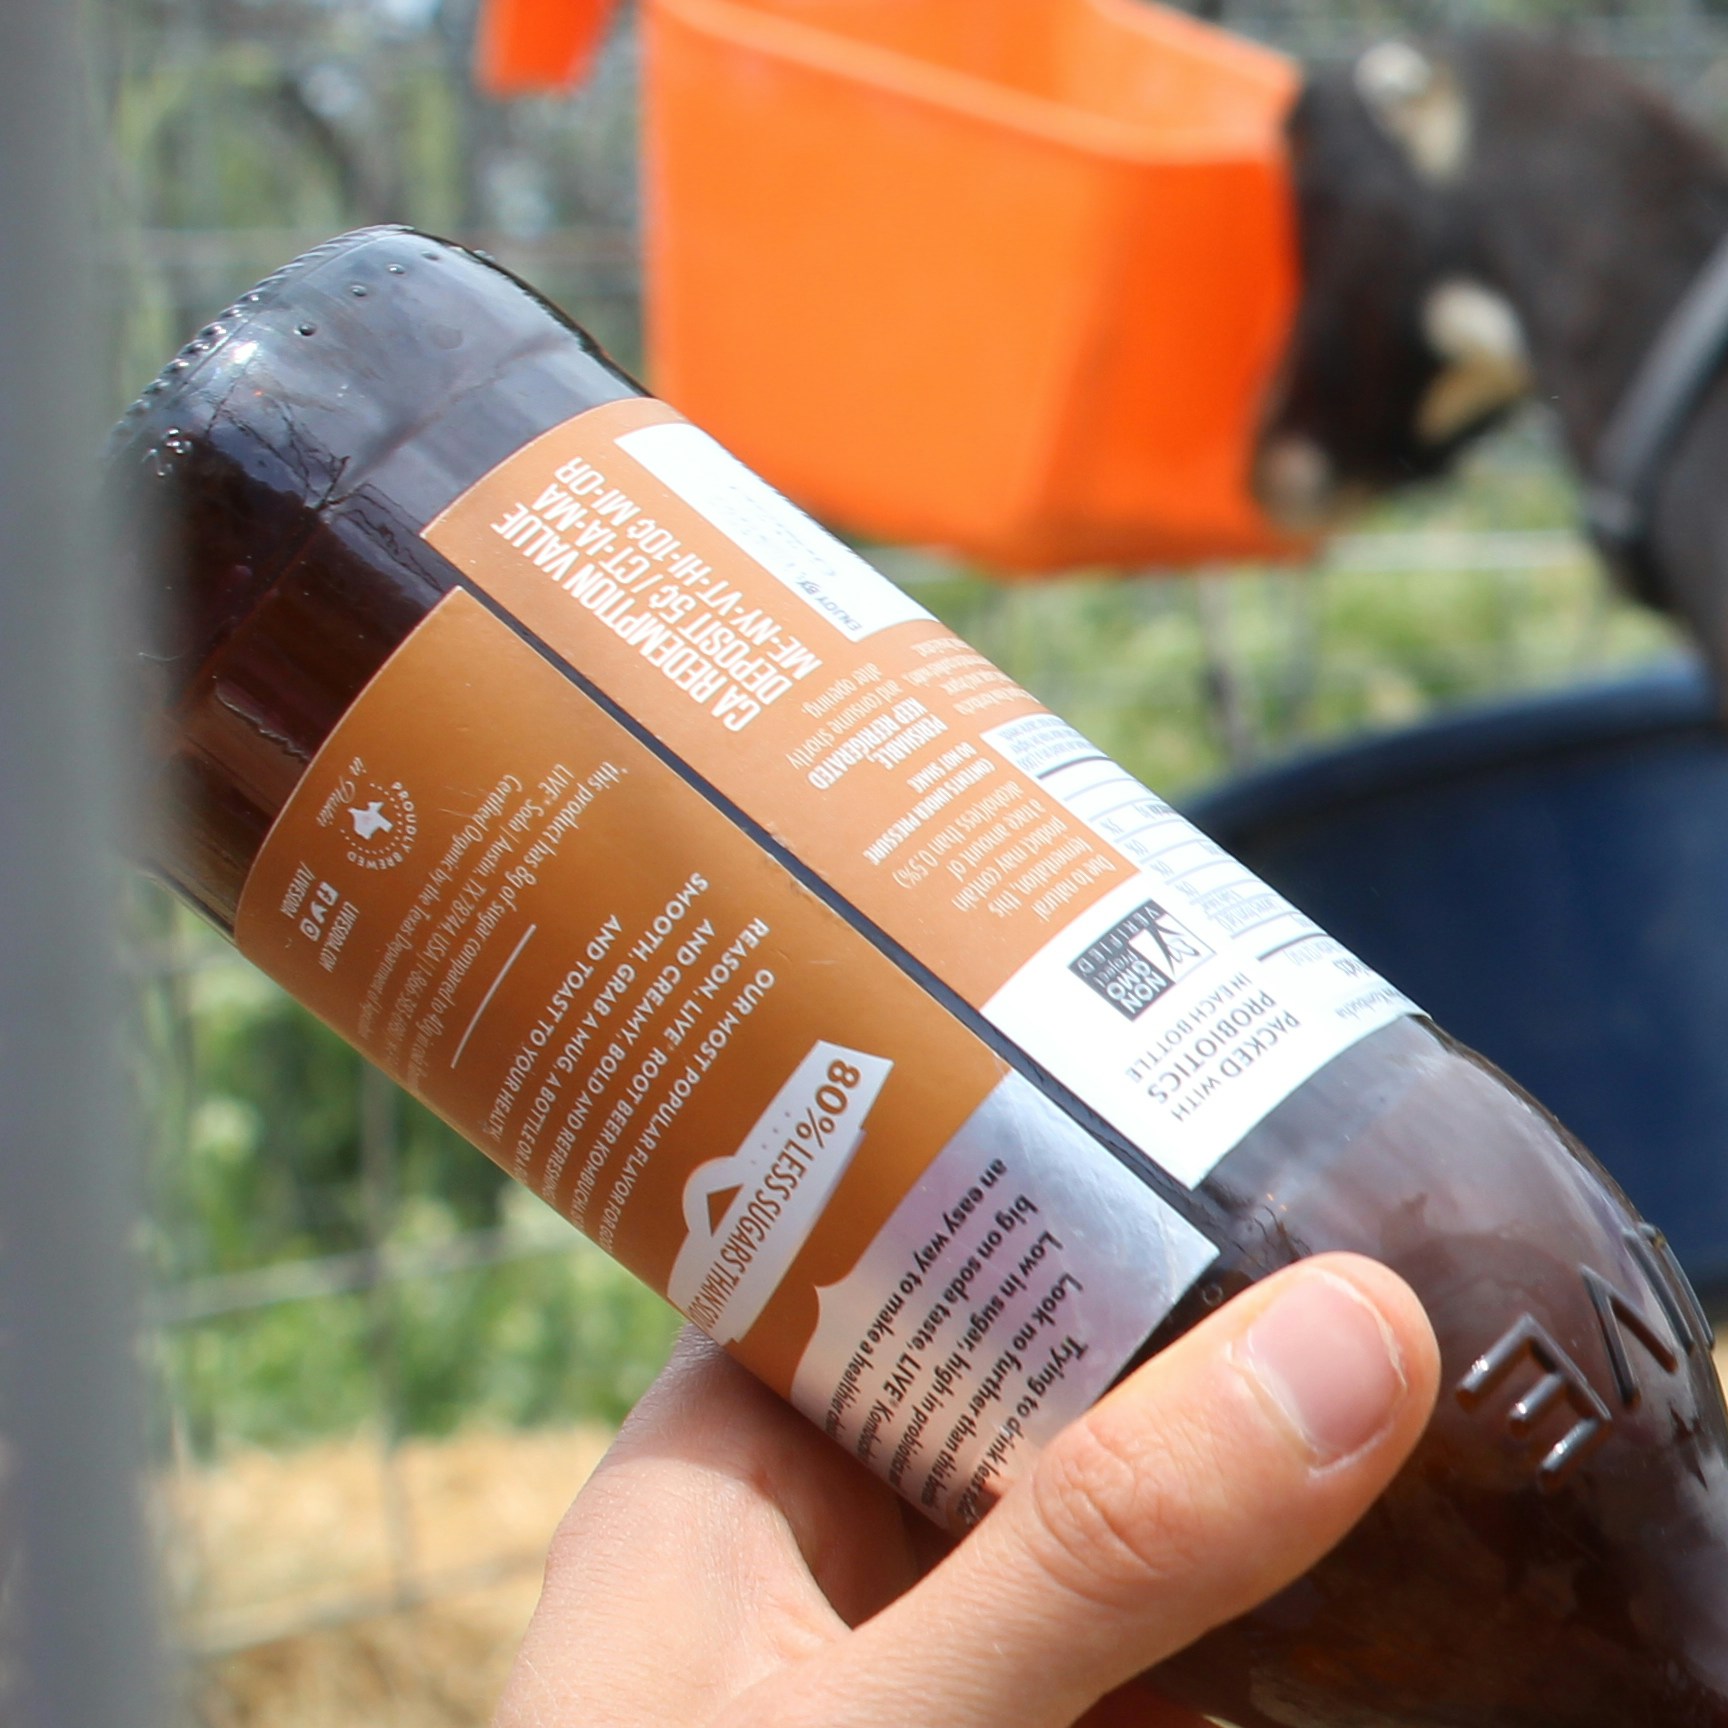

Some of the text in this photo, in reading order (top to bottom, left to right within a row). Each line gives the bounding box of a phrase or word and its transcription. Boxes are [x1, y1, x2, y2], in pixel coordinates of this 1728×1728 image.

[551, 455, 641, 527] MI-OR
[529, 480, 654, 586] CT-IA-MA
[488, 501, 762, 734] CA REDEMPTION VALUE
[643, 579, 698, 627] 5¢
[812, 593, 863, 633] ENJOY
[674, 613, 793, 706] DEPOSIT
[848, 660, 883, 685] after
[798, 676, 856, 721] opening.
[825, 691, 883, 736] consume
[873, 677, 903, 705] and
[887, 695, 928, 725] KEEP
[784, 727, 835, 771] shortly
[804, 711, 902, 792] REFRIGERATED
[864, 712, 949, 773] PERISHABLE,
[936, 748, 965, 772] NOT
[952, 739, 977, 759] DO
[313, 755, 369, 829] in Austin
[471, 770, 524, 832] Certified
[904, 761, 947, 794] SHAKE
[343, 780, 419, 872] PROUDLY BREWED
[506, 798, 543, 836] Soda
[541, 781, 595, 845] product
[860, 755, 996, 867] CONTENTS UNDER PRESSURE
[890, 778, 1025, 891] alcohol(less than 0.5%)
[439, 822, 484, 874] Organic
[471, 833, 514, 880] Austin,
[522, 838, 556, 870] has
[943, 797, 1047, 884] a trace amount of
[950, 814, 1068, 916] product may contain
[277, 859, 316, 920] /LIVESODA
[416, 882, 442, 909] the
[426, 866, 454, 888] by
[462, 876, 487, 900] TX
[496, 883, 520, 911] of
[504, 864, 537, 892] 8g
[985, 835, 1094, 919] fermentation, this
[1029, 853, 1118, 923] Due to natural
[314, 900, 360, 974] LIVESODA.COM
[398, 902, 431, 938] Texas
[437, 892, 474, 938] 78744,
[471, 900, 504, 940] sugar
[583, 913, 622, 963] AND
[367, 929, 410, 999] Department
[421, 930, 452, 963] USA
[672, 918, 715, 971] AND
[693, 915, 770, 1003] REASON,
[1072, 904, 1161, 981] VERIFIED
[437, 936, 481, 1006] compared
[543, 957, 593, 1022] TOAST
[591, 961, 636, 1017] GRAB
[730, 965, 776, 1018] OUR
[1090, 948, 1138, 990] Project
[1103, 957, 1153, 1002] GMO
[1119, 969, 1168, 1016] NON
[364, 989, 386, 1009] of
[428, 995, 449, 1015] to
[580, 1010, 600, 1031] A
[615, 961, 682, 1048] CREAMY,
[414, 1011, 446, 1042] 40g
[525, 1016, 555, 1051] TO
[551, 1026, 590, 1077] MUG,
[689, 1010, 741, 1072] MOST
[1123, 970, 1253, 1085] IN EACH BOTTLE
[1144, 988, 1277, 1106] PROBIOTICS
[501, 1043, 538, 1094] YOUR
[544, 1071, 562, 1091] A
[583, 1042, 625, 1097] BOLD
[622, 1045, 668, 1106] ROOT
[1167, 1008, 1302, 1124] PACKED WITH
[520, 1085, 557, 1145] BOTTLE
[563, 1089, 593, 1131] AND
[598, 1098, 634, 1147] BEER
[636, 1064, 699, 1152] POPULAR
[792, 1055, 864, 1151] 80%
[513, 1138, 533, 1163] OR
[761, 1138, 816, 1202] LESS
[978, 1157, 1010, 1191] an
[568, 1139, 611, 1215] KOMBUCHA
[606, 1144, 649, 1210] FLAVOR
[599, 1199, 623, 1233] FOR
[717, 1190, 783, 1272] SUGARS
[938, 1184, 984, 1236] easy
[993, 1193, 1038, 1235] big
[911, 1231, 950, 1274] way
[975, 1229, 1006, 1260] on
[1016, 1228, 1063, 1278] Low
[696, 1259, 741, 1310] THAN
[897, 1270, 924, 1295] to
[941, 1254, 987, 1307] soda
[997, 1272, 1027, 1299] in
[1030, 1271, 1083, 1330] Look
[864, 1292, 908, 1346] make
[905, 1301, 951, 1356] taste,
[954, 1292, 1008, 1357] sugar,
[1010, 1321, 1039, 1353] no
[858, 1340, 873, 1355] a
[1025, 1332, 1088, 1401] Trying
[827, 1350, 874, 1419] healthier
[918, 1390, 943, 1412] in
[926, 1353, 971, 1399] high
[964, 1347, 1022, 1420] further
[1013, 1394, 1041, 1420] to
[942, 1412, 982, 1454] than
[983, 1415, 1026, 1467] drink
[928, 1448, 960, 1480] this
[967, 1459, 1000, 1492] less
